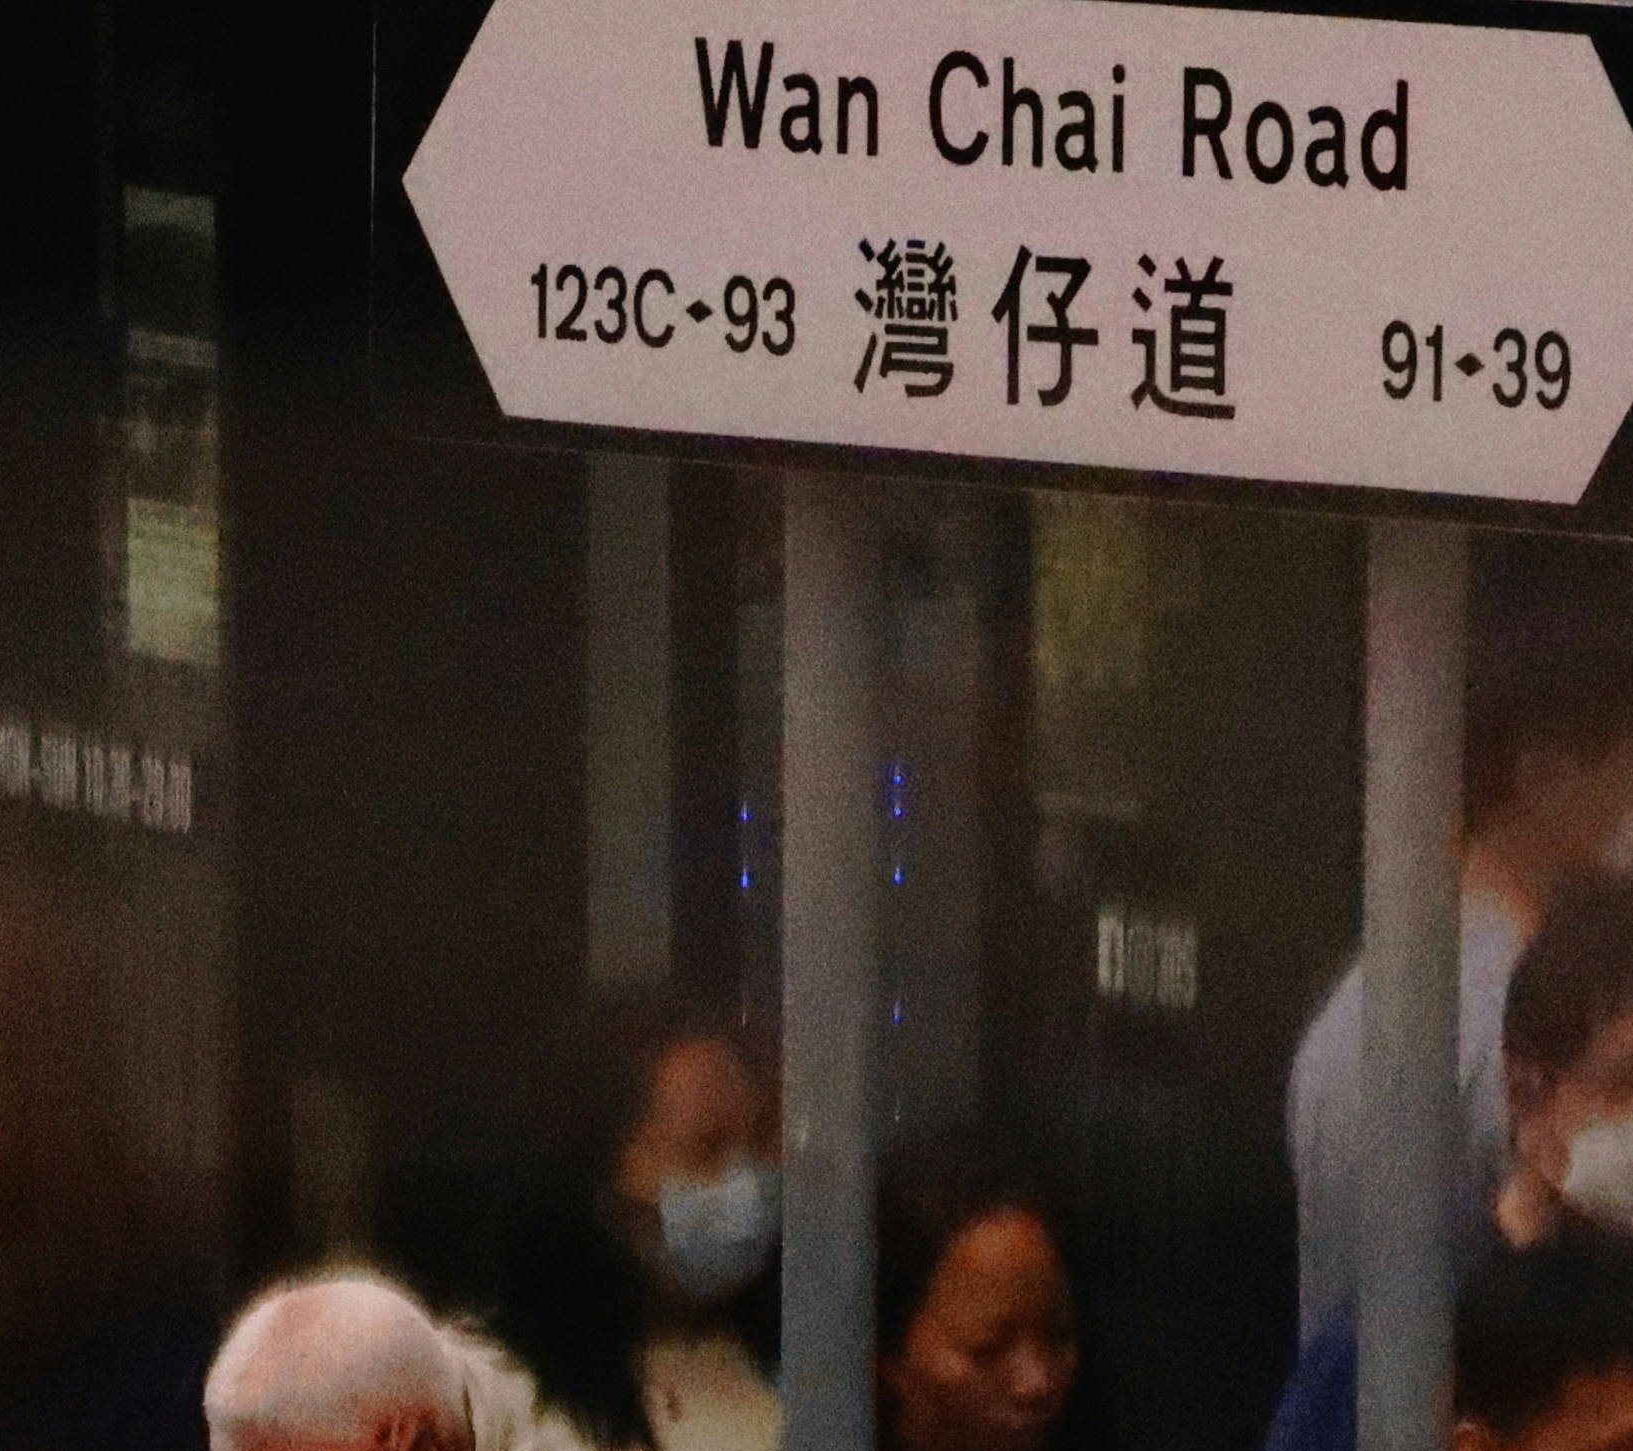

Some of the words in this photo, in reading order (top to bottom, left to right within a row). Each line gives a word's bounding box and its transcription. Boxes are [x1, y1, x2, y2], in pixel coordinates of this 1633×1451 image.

[694, 36, 881, 158] Wan
[927, 49, 1128, 174] Chai
[1181, 66, 1411, 192] Road
[853, 238, 1237, 422] 灣仔道
